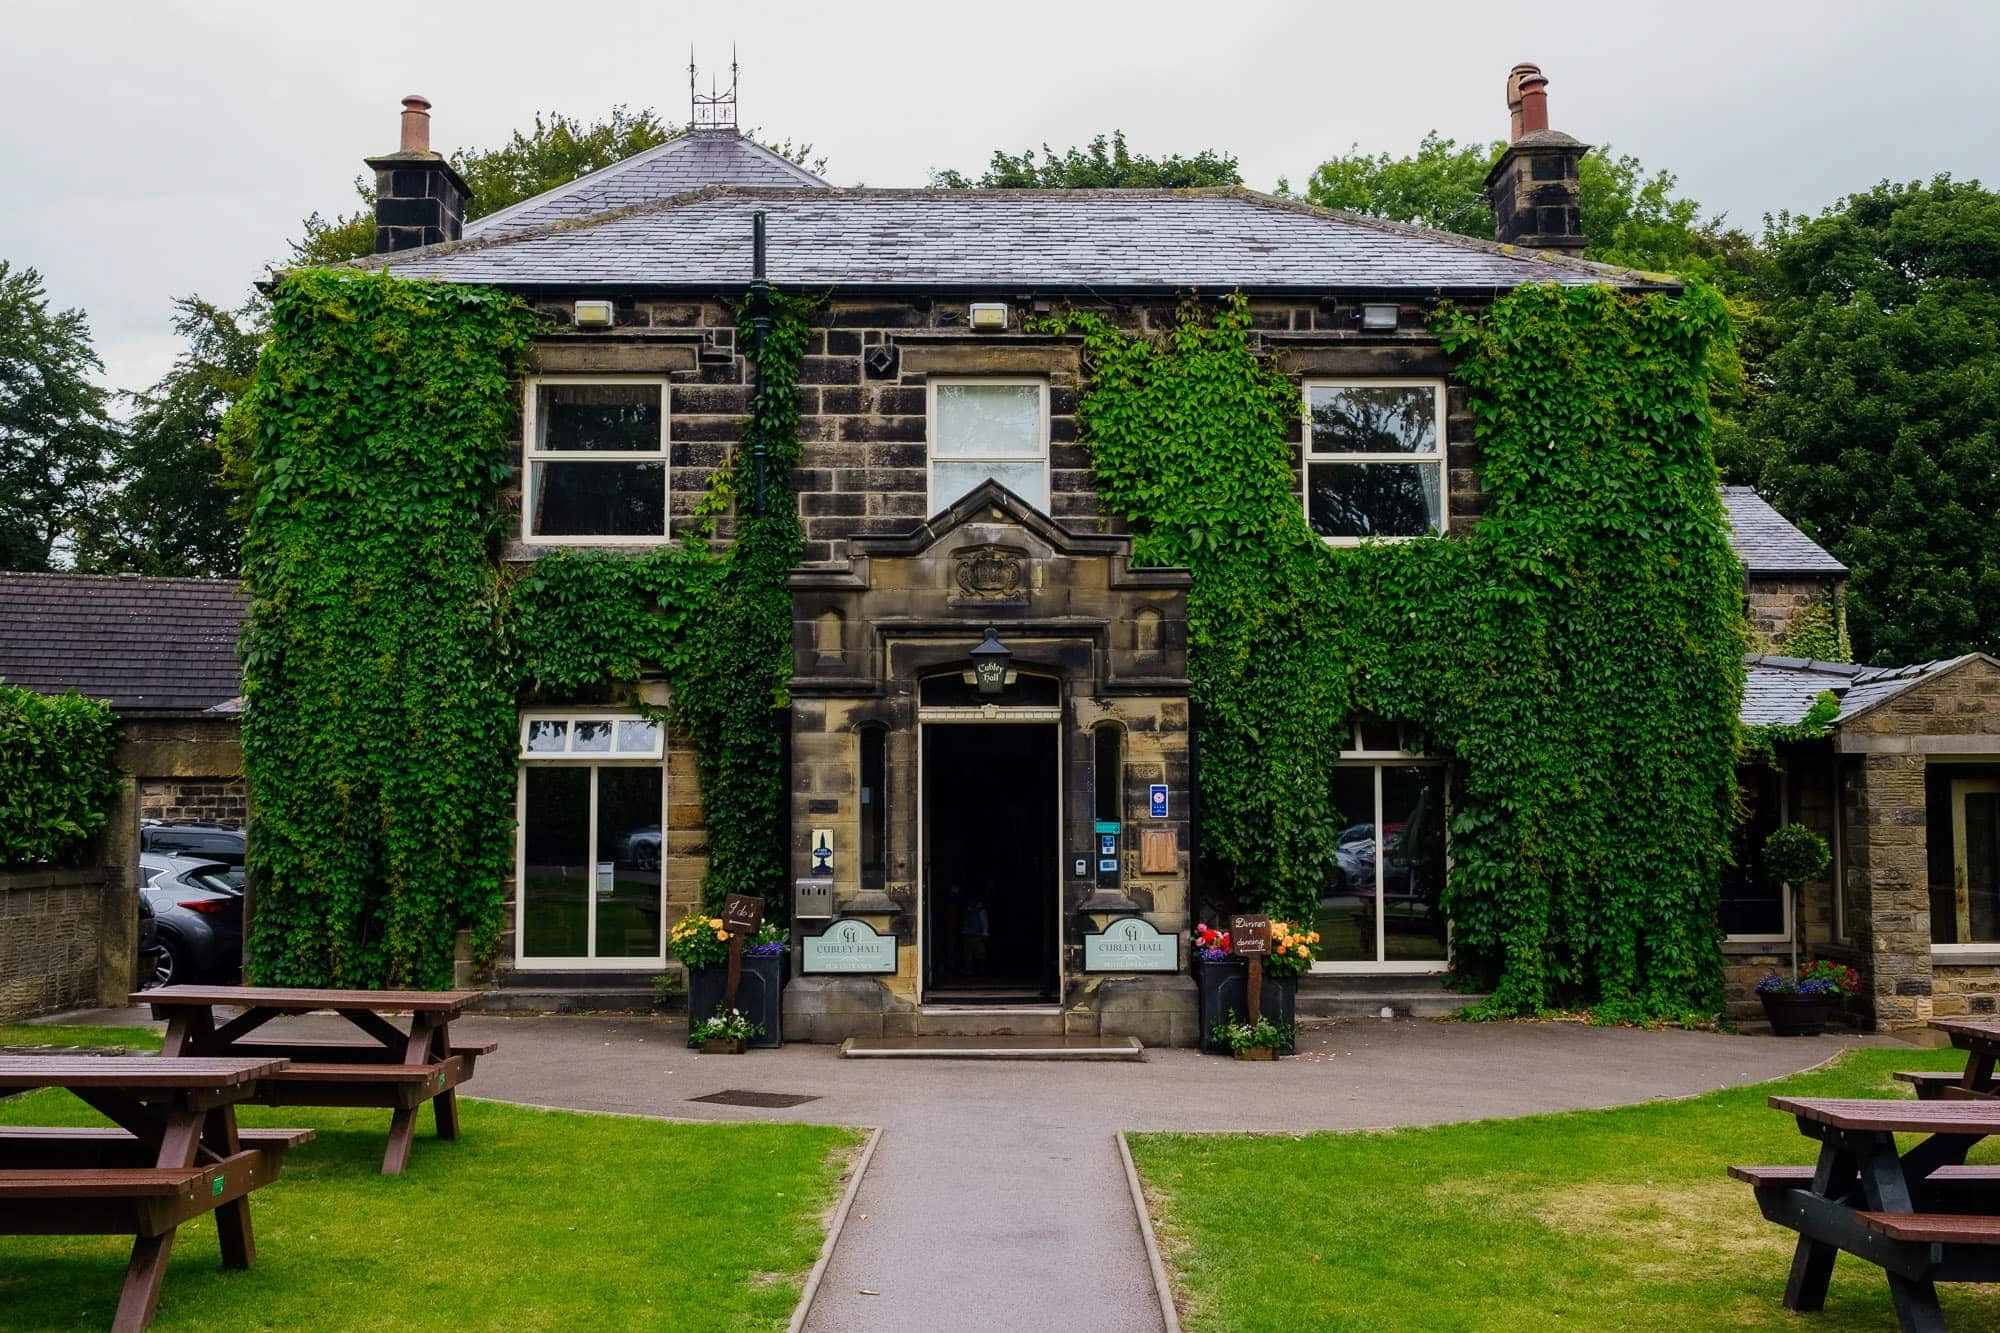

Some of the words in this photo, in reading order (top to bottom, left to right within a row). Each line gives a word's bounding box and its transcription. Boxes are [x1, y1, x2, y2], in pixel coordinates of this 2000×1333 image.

[978, 663, 1003, 674] Cubley
[984, 672, 999, 683] Hall
[816, 945, 853, 953] CUBLEY
[857, 945, 880, 953] HALL
[1098, 943, 1135, 952] CUBLEY
[1138, 943, 1165, 952] HALL
